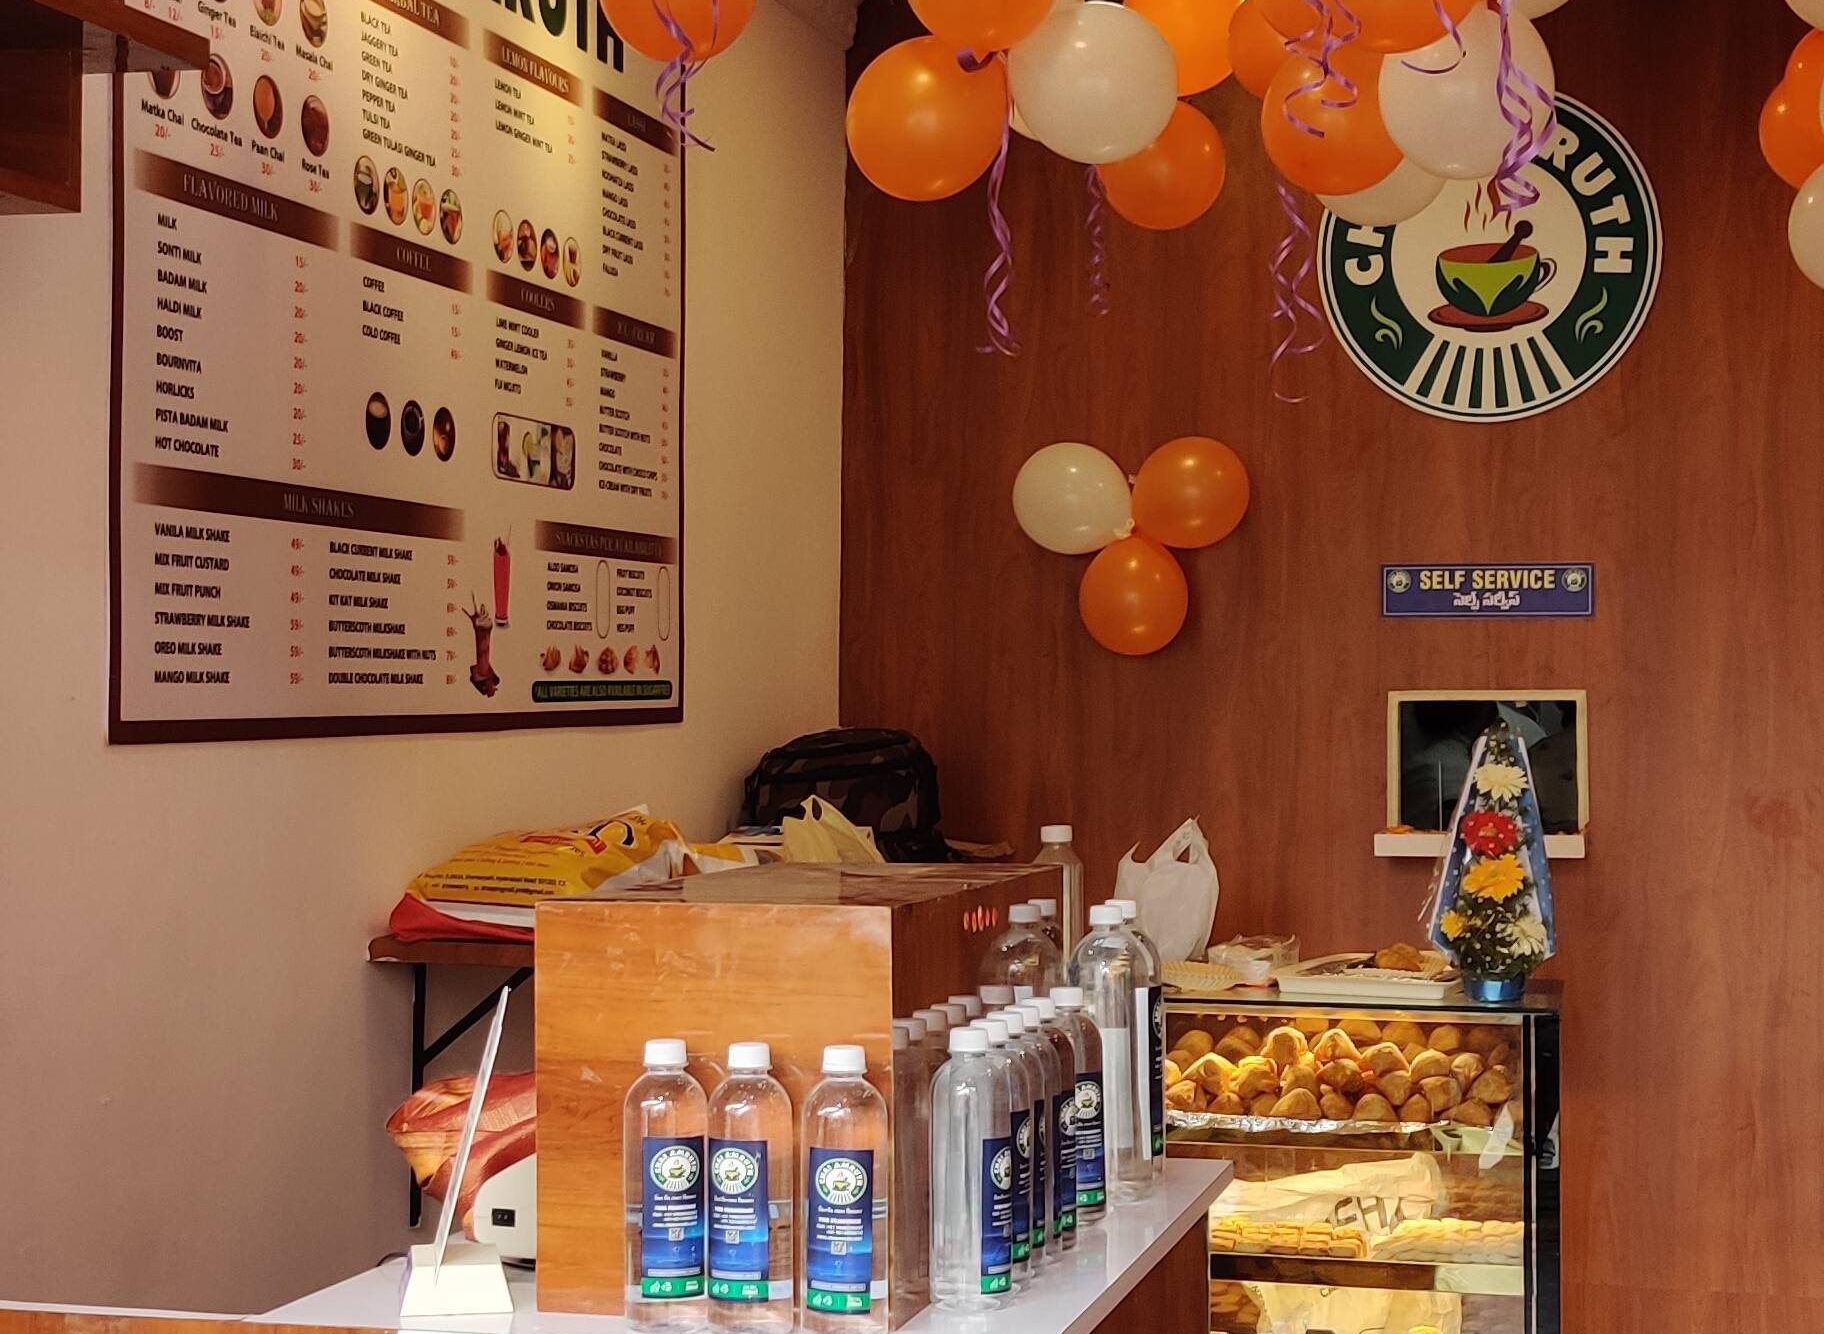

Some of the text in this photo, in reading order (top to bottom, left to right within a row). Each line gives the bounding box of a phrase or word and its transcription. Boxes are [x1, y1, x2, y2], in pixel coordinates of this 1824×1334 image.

[197, 0, 237, 28] Ginger Tea
[420, 1, 441, 27] TEA
[272, 33, 285, 51] Tea
[295, 44, 334, 70] Masala Chai
[141, 98, 184, 127] Matka Chai
[191, 117, 242, 148] Chocolate Tea
[251, 139, 285, 163] Paan Chai
[301, 157, 330, 180] Rose Tea
[182, 173, 279, 222] FLAVORED MILK
[1536, 122, 1634, 274] RUTH
[157, 213, 177, 230] MILK
[157, 240, 202, 265] SONTI MILK
[396, 247, 432, 272] COFFEE
[157, 268, 207, 294] BADAM MILK
[362, 276, 385, 293] COFFEE
[157, 296, 202, 319] HALDI MILK
[362, 300, 404, 322] BLACK COFFEE
[156, 323, 183, 343] BOOST
[362, 324, 401, 345] COLD COFFEE
[156, 352, 202, 374] BOURNVITA
[155, 380, 194, 400] HORLICKS
[155, 407, 229, 433] PISTA BADAM MILK
[155, 435, 220, 458] HOT CHOCOLATE
[283, 492, 354, 518] MILK SHAKES
[155, 523, 230, 543] VANILA MILK SHAKE
[155, 553, 230, 571] MIX FRUIT CUSTARD
[329, 541, 413, 561] BLACK CURRENT MILK SHAKE
[329, 568, 401, 585] CHOCOLATE MILK SHAKE
[1419, 569, 1466, 591] SELF
[1471, 569, 1556, 591] SERVICE
[155, 582, 221, 599] MIX FRUIT PUNCH
[329, 594, 389, 609] KIT KAT MILK SHAKE
[155, 611, 250, 629] STRAWBERRY MILK SHAKE
[155, 641, 222, 656] OREO MILK SHAKE
[155, 670, 230, 684] MANGO MILK SHAKE
[328, 672, 424, 685] DOUBLE CHOCOLATE MILK SHAKE
